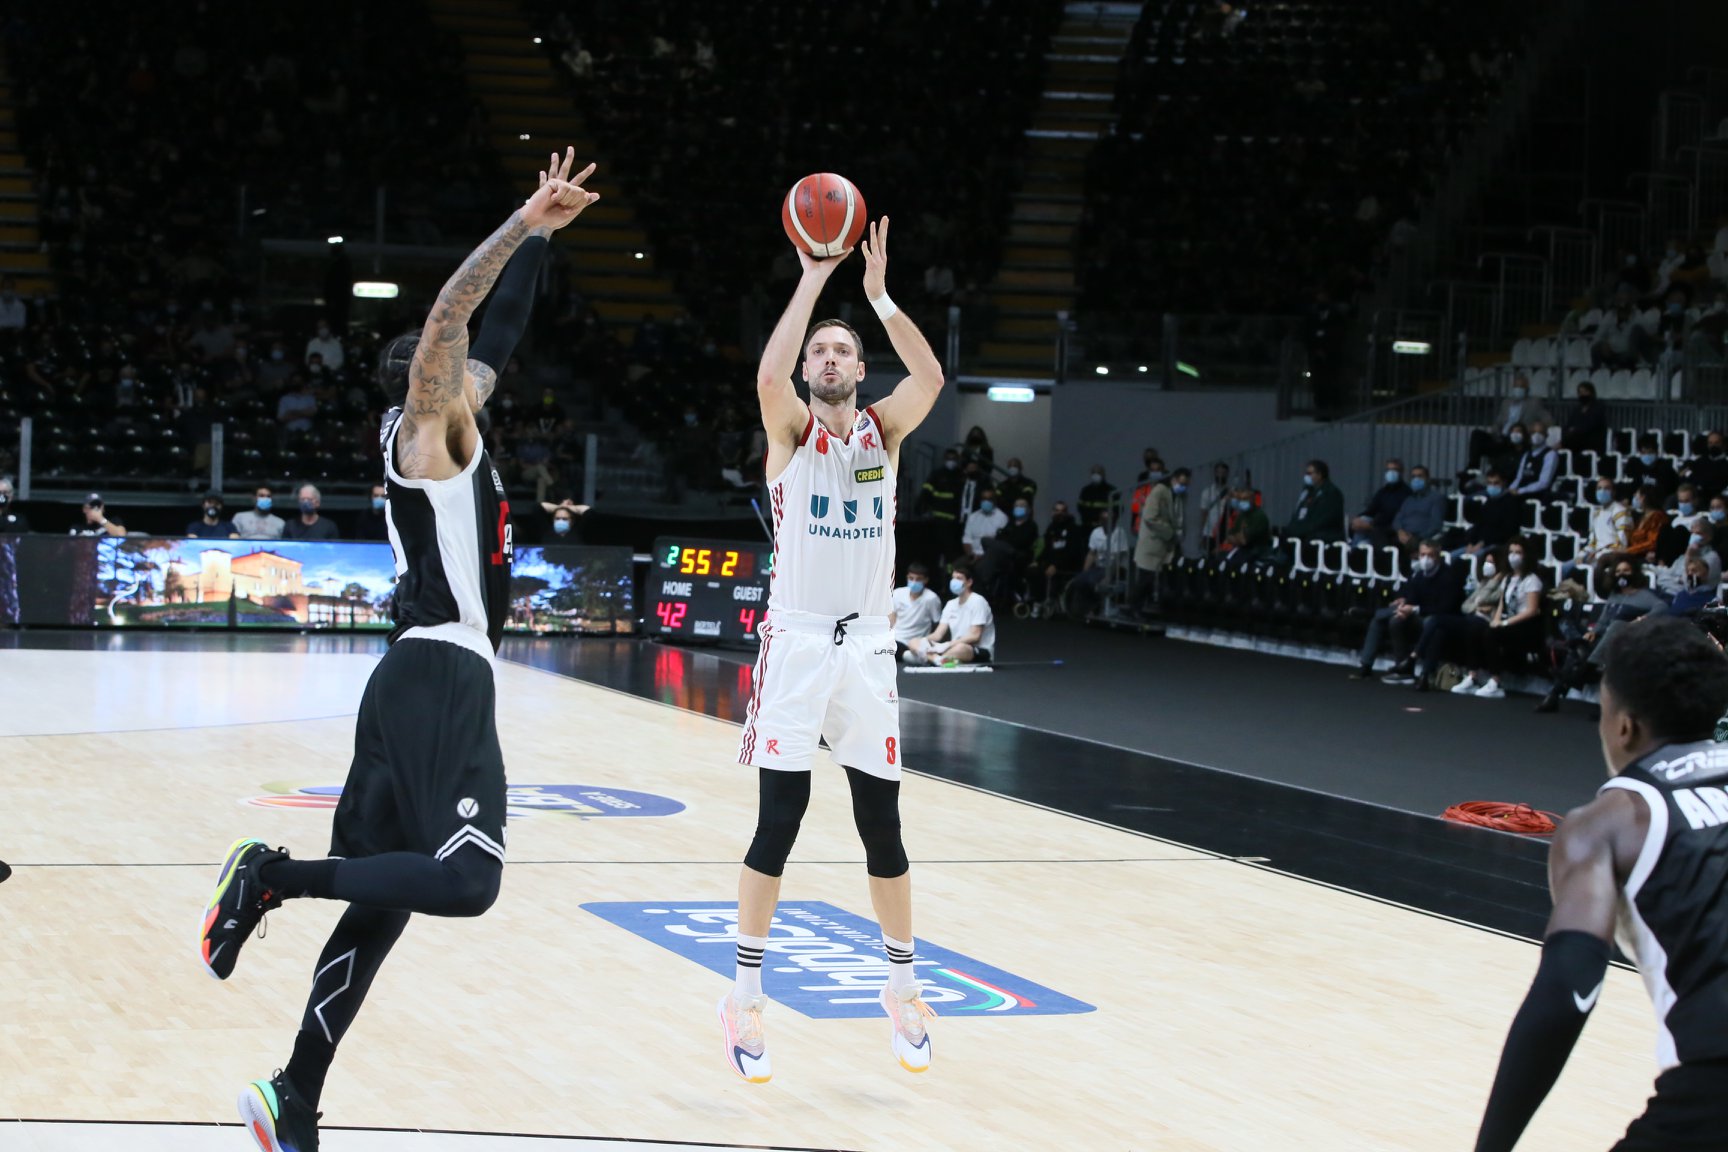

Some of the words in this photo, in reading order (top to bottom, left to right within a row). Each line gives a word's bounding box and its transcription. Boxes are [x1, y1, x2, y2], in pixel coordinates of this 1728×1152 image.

[815, 427, 829, 455] 8
[666, 545, 680, 565] 2
[662, 581, 693, 597] HOME
[733, 585, 764, 601] GUEST
[656, 601, 688, 628] 42
[739, 608, 768, 633] 4
[885, 736, 897, 765] 8
